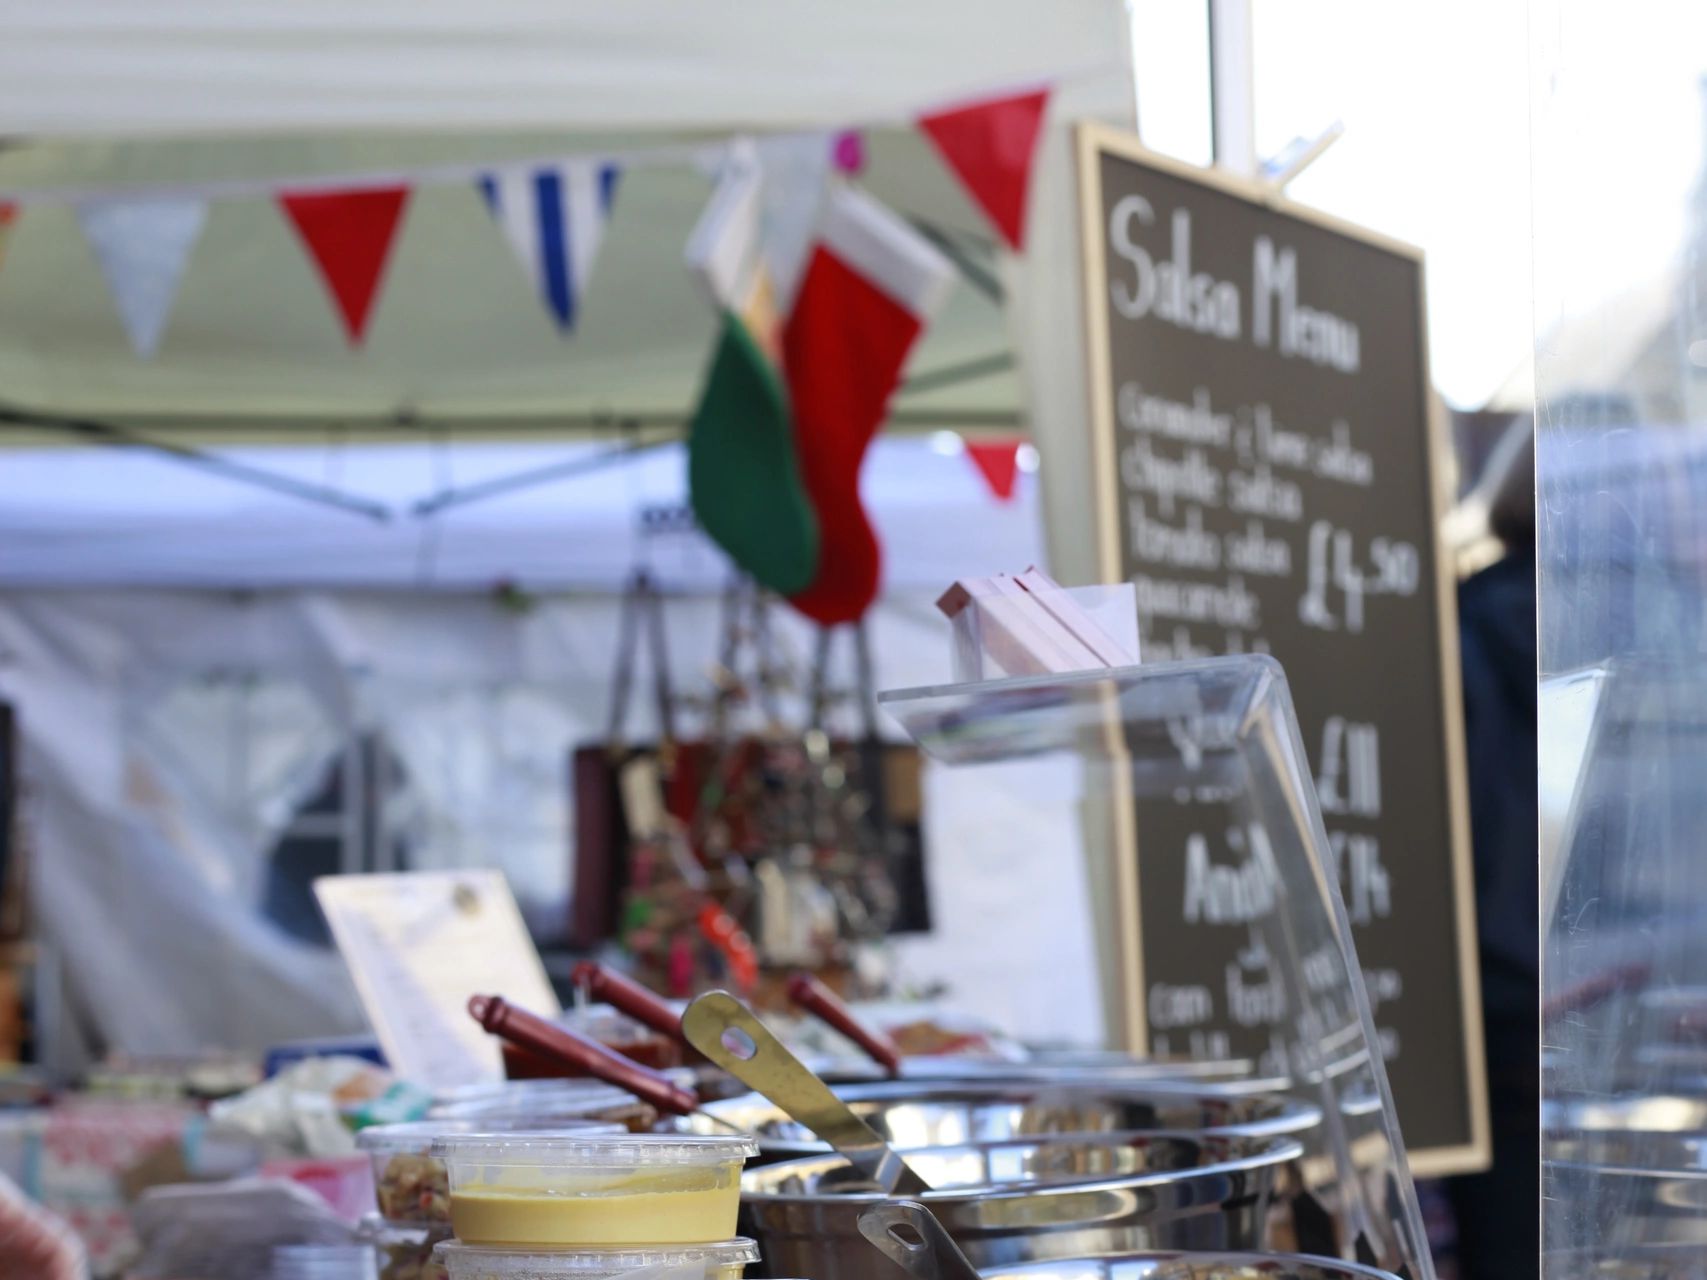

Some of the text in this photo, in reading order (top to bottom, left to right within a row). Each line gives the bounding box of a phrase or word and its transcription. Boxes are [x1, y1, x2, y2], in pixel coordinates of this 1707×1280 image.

[1110, 194, 1361, 374] Salsa Menu
[1312, 417, 1374, 487] salsa
[1226, 462, 1304, 523] salsa
[1224, 517, 1292, 578] salsa
